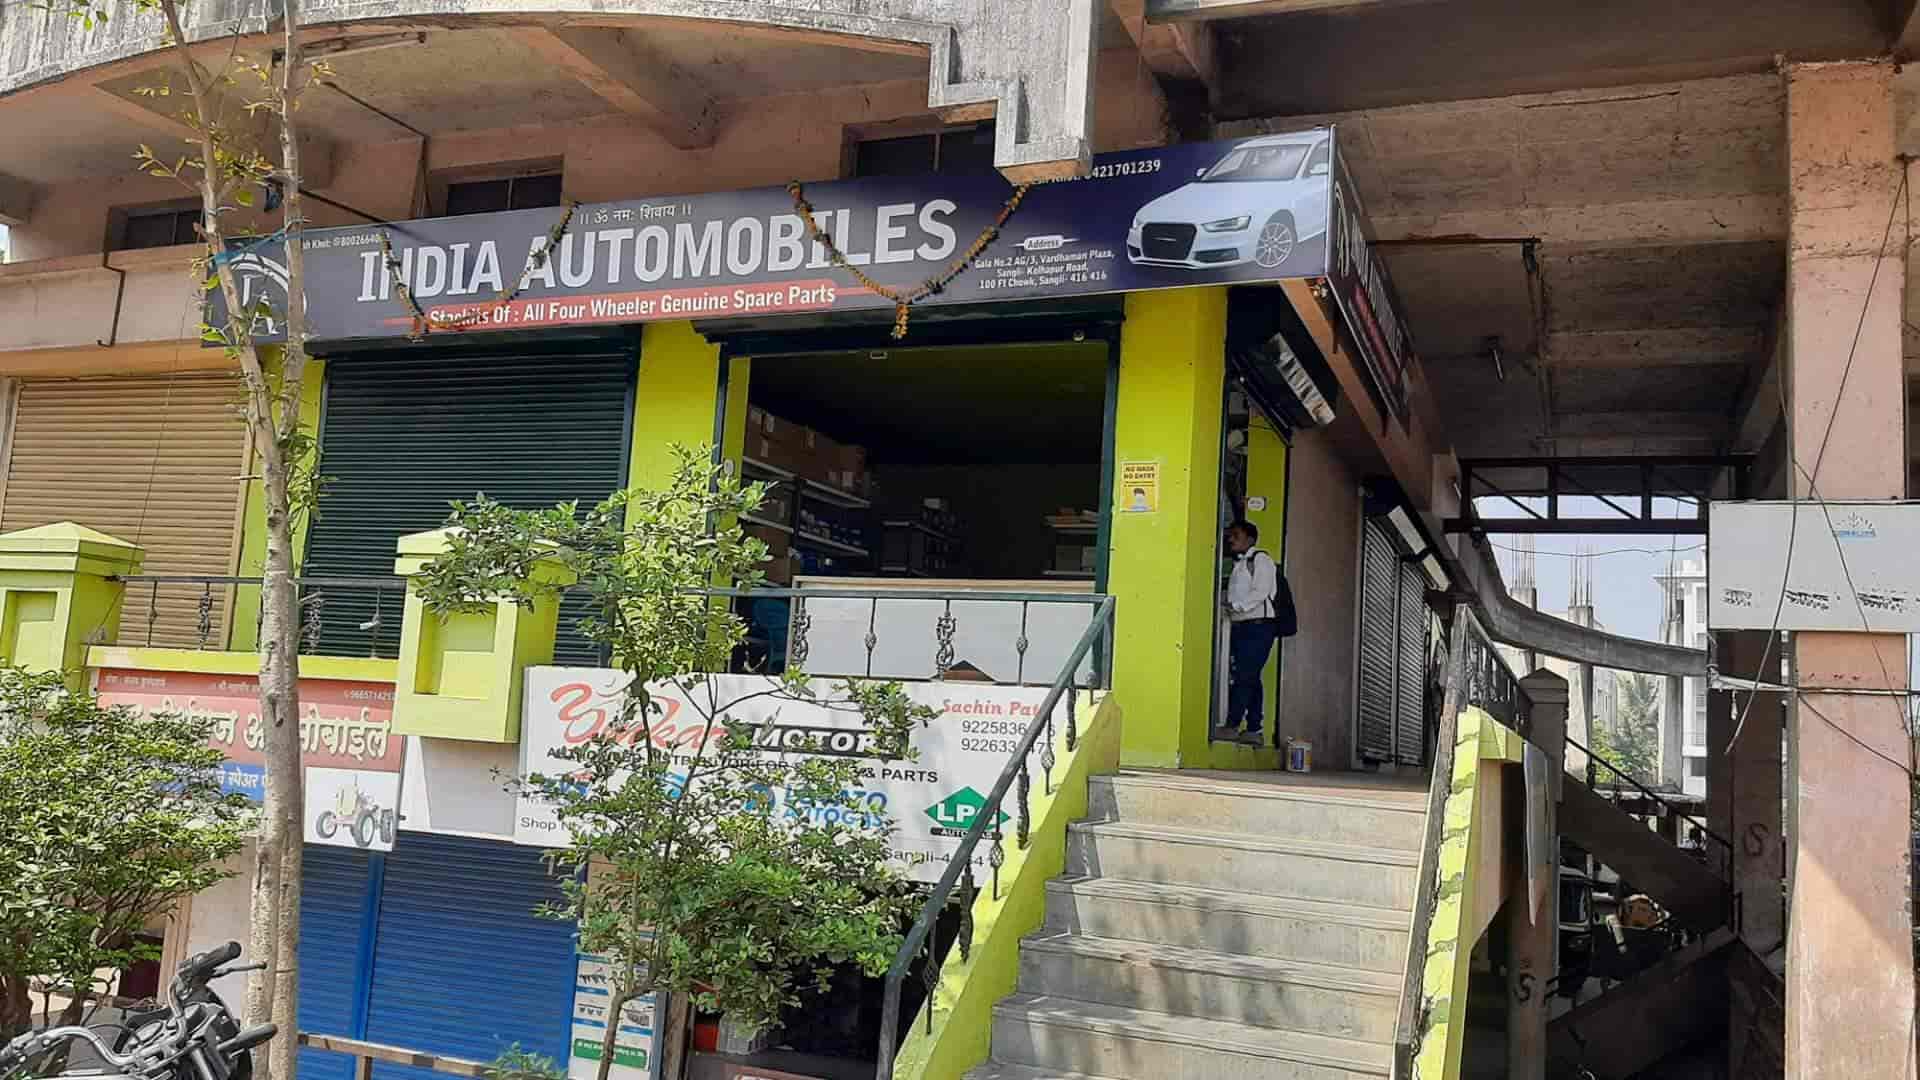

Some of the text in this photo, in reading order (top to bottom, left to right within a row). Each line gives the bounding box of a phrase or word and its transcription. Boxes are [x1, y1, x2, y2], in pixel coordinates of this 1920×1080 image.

[639, 203, 676, 220] शिवाय
[357, 198, 958, 302] INDIA AUTOMOBILES
[1027, 239, 1060, 249] Address
[979, 279, 996, 289] 100
[1070, 272, 1088, 282] 416
[1090, 271, 1107, 281] 416
[493, 305, 511, 324] Of
[523, 303, 545, 322] All
[549, 301, 586, 321] Four
[591, 297, 656, 317] Wheeler
[661, 292, 728, 314] Genuine
[733, 289, 784, 311] Spare
[788, 284, 836, 305] Parts
[943, 698, 1002, 715] Sachin
[751, 725, 898, 755] MOTOR
[881, 768, 939, 783] PARTS
[519, 816, 557, 832] Shop
